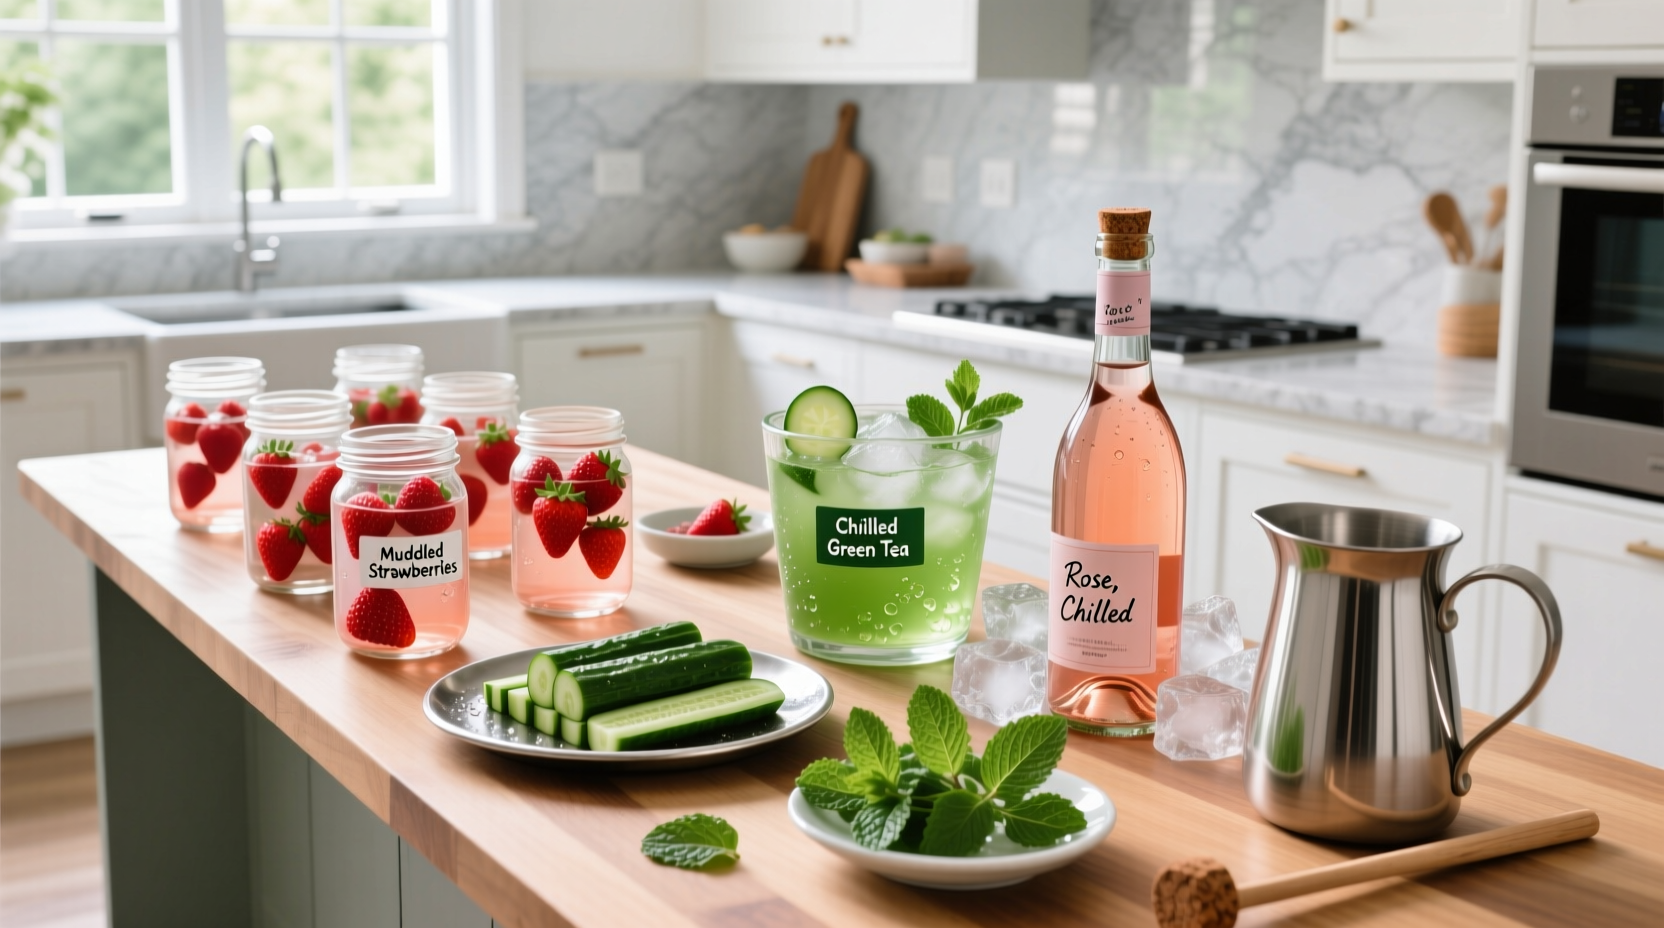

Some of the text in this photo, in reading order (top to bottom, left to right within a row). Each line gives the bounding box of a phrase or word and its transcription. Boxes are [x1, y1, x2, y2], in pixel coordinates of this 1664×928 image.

[380, 541, 444, 562] Muddled
[827, 538, 910, 558] Green Tea
[368, 559, 458, 579] Strawberries
[1064, 560, 1119, 594] Rose,
[1060, 594, 1136, 624] Chilled
